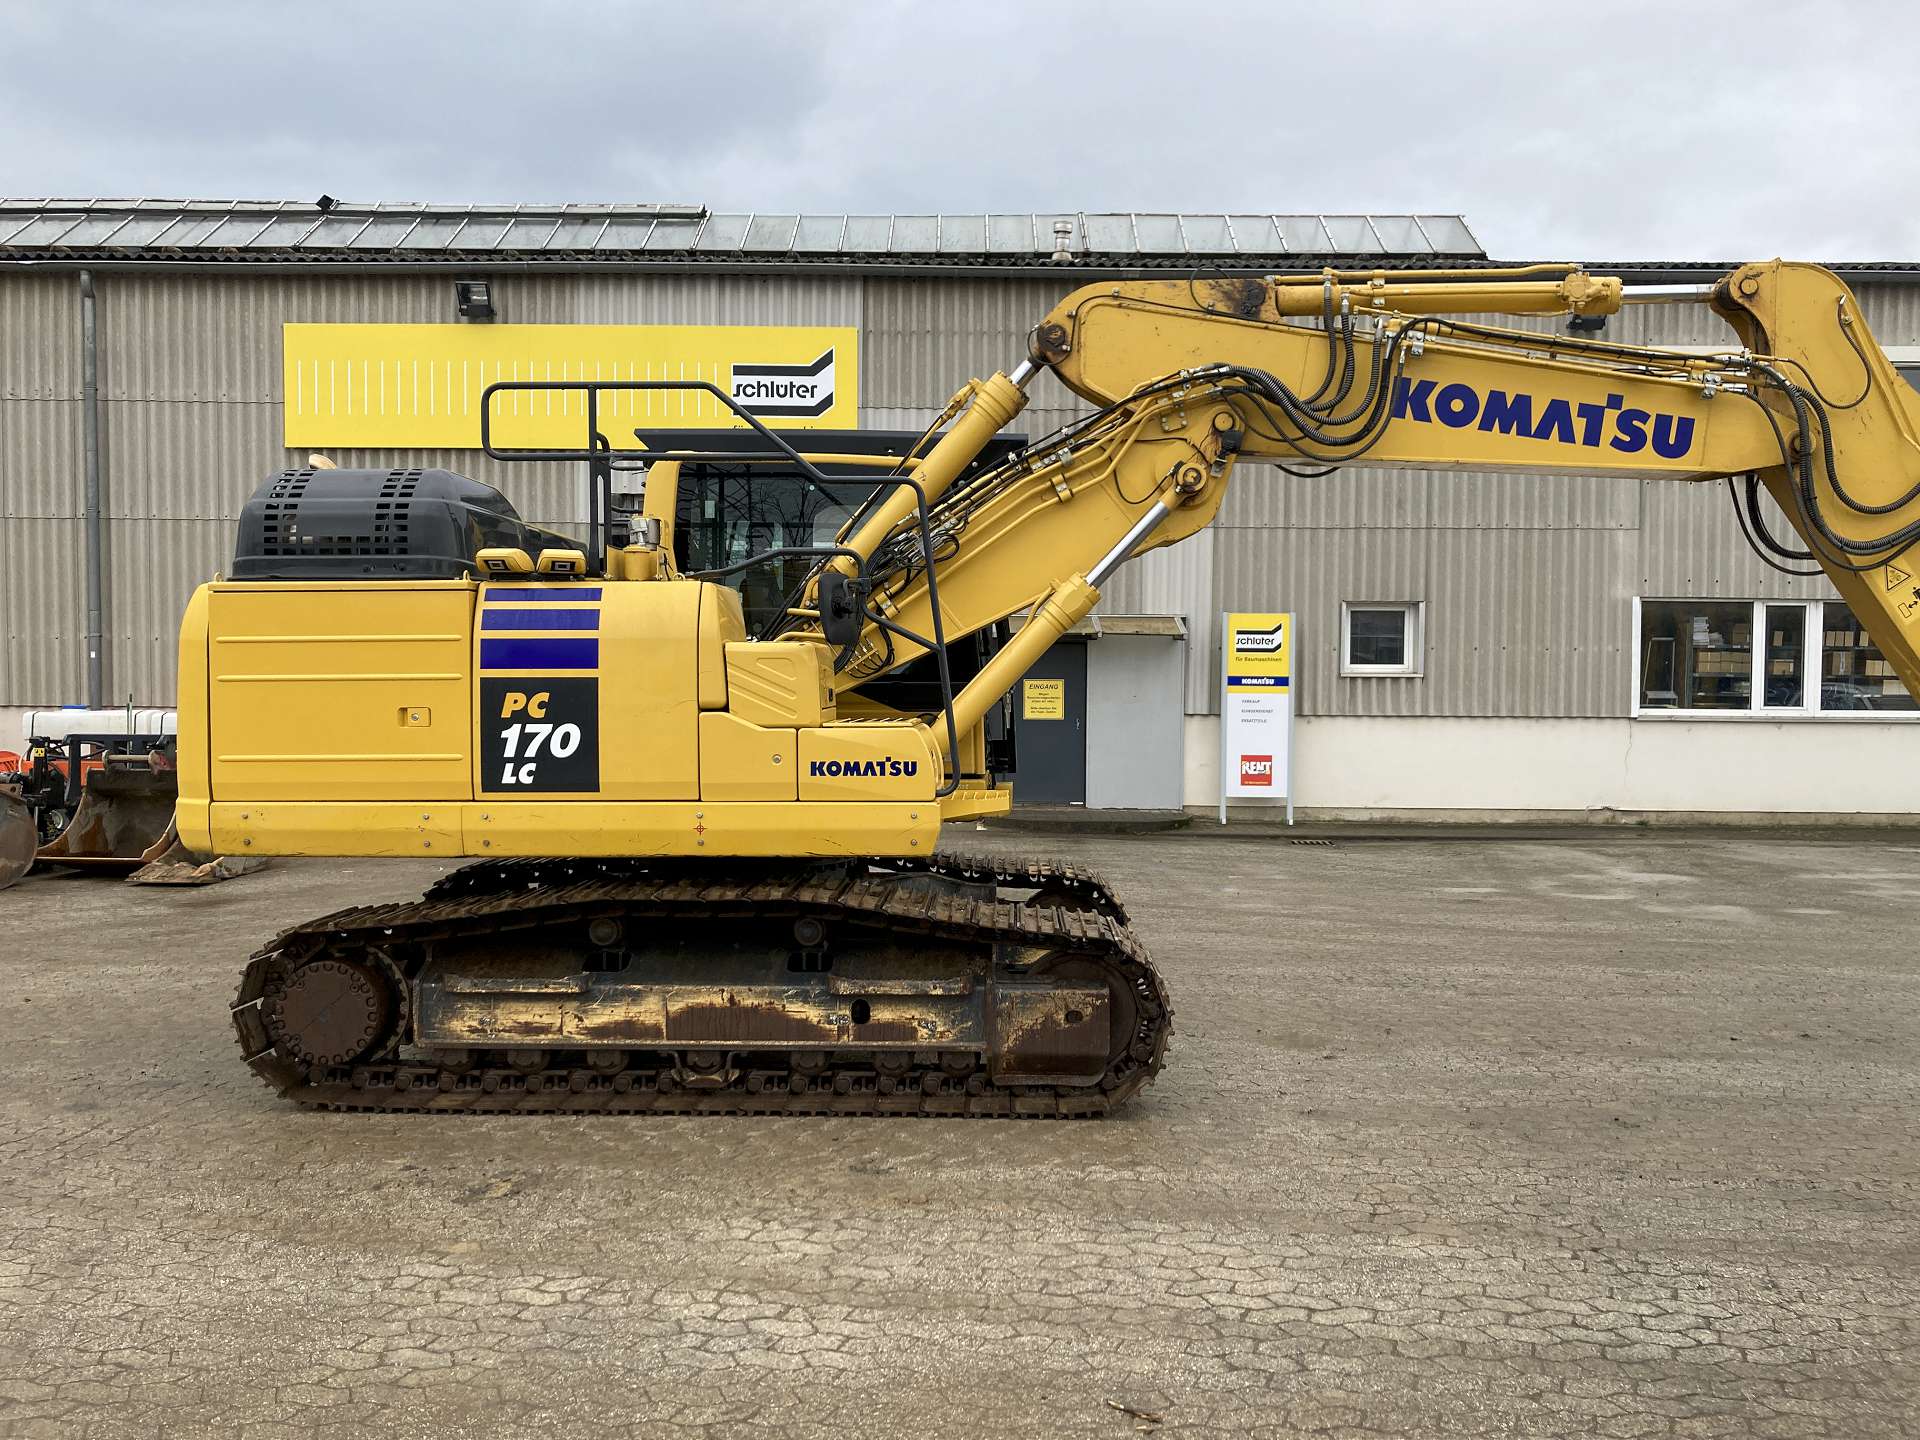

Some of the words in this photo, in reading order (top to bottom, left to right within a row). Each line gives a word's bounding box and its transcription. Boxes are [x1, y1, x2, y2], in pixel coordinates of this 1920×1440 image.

[1391, 376, 1696, 459] KOMATSU
[1241, 677, 1275, 685] KOMATSU
[501, 692, 550, 719] PC
[501, 723, 581, 759] 170
[501, 762, 537, 784] LC
[810, 756, 918, 777] KOMATSU
[1241, 761, 1271, 774] RENT
